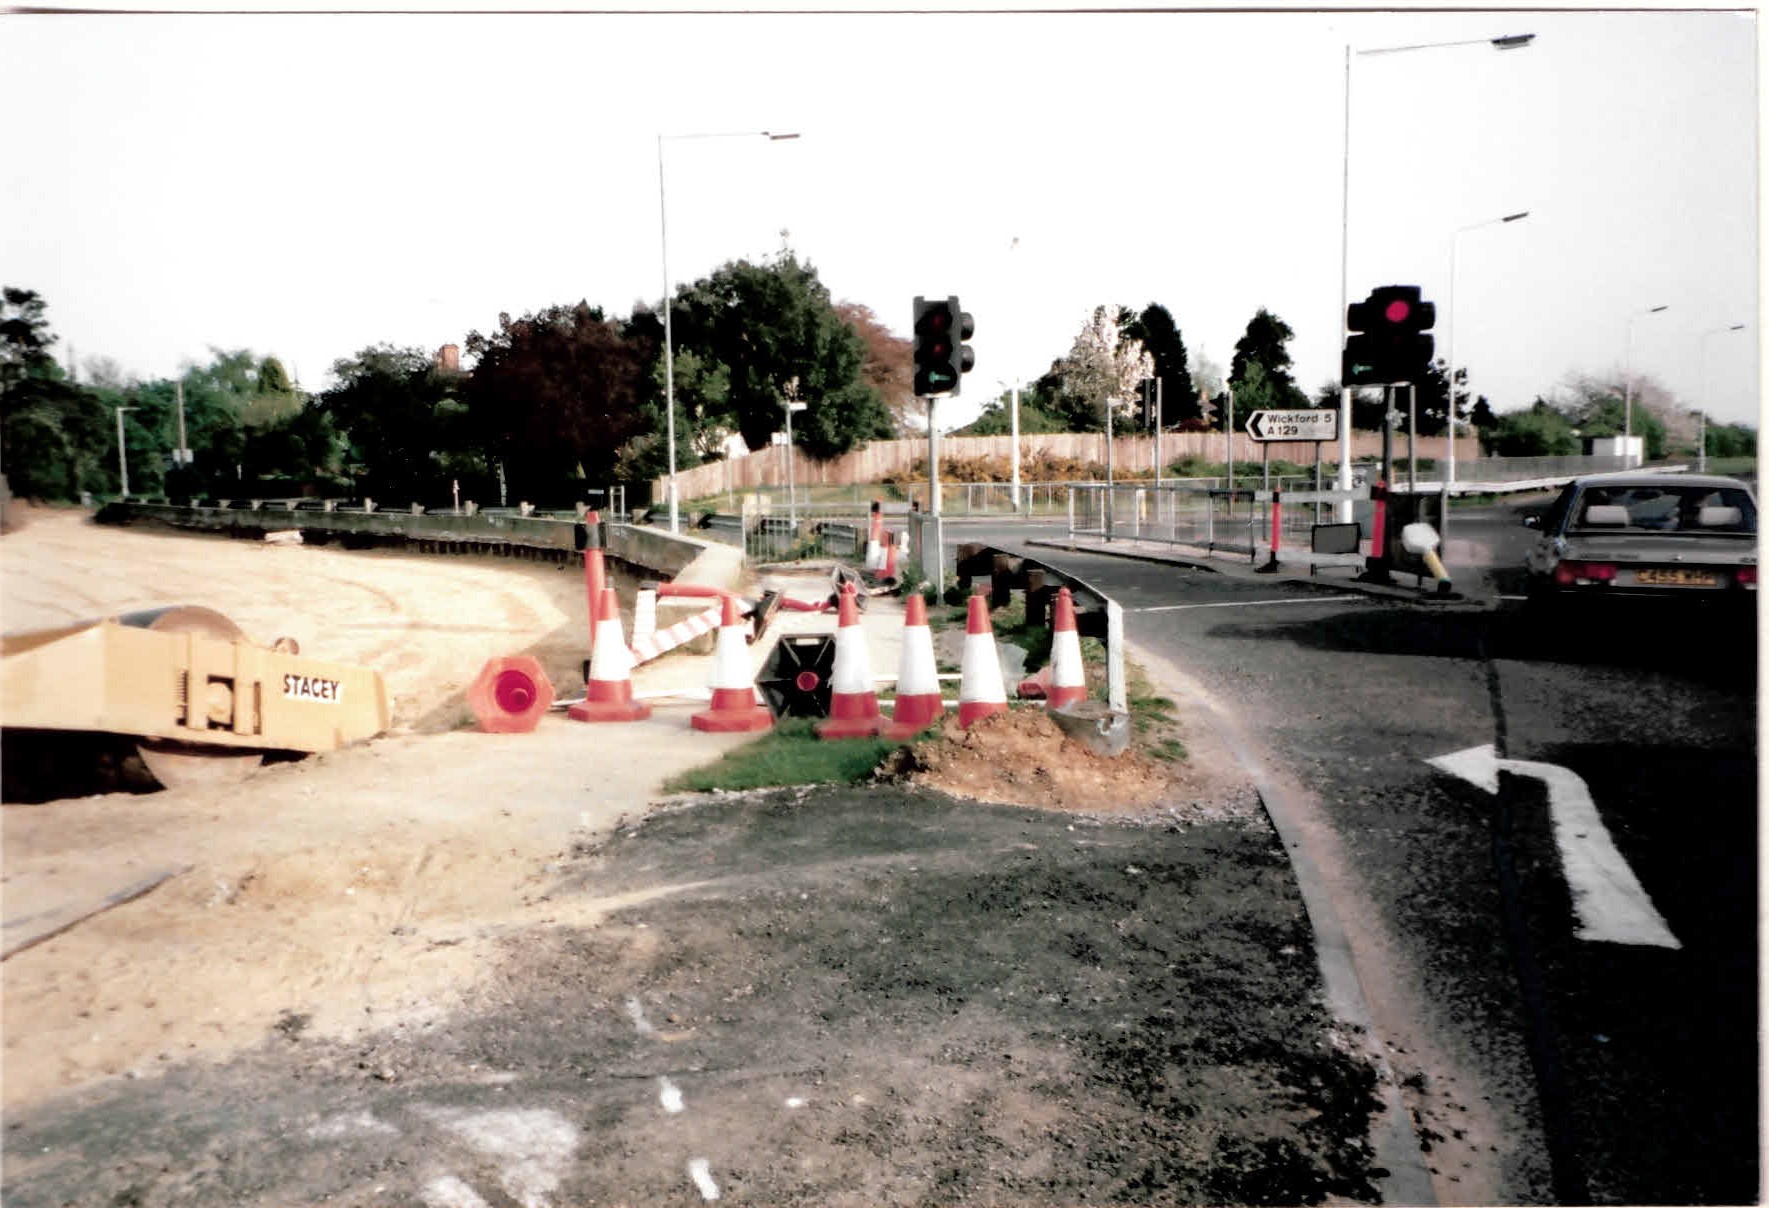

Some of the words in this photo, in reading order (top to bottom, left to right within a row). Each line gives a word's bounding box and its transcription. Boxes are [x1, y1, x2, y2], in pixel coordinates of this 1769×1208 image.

[1268, 414, 1318, 423] Wickford
[1324, 414, 1332, 423] 5
[283, 673, 339, 701] STACEY
